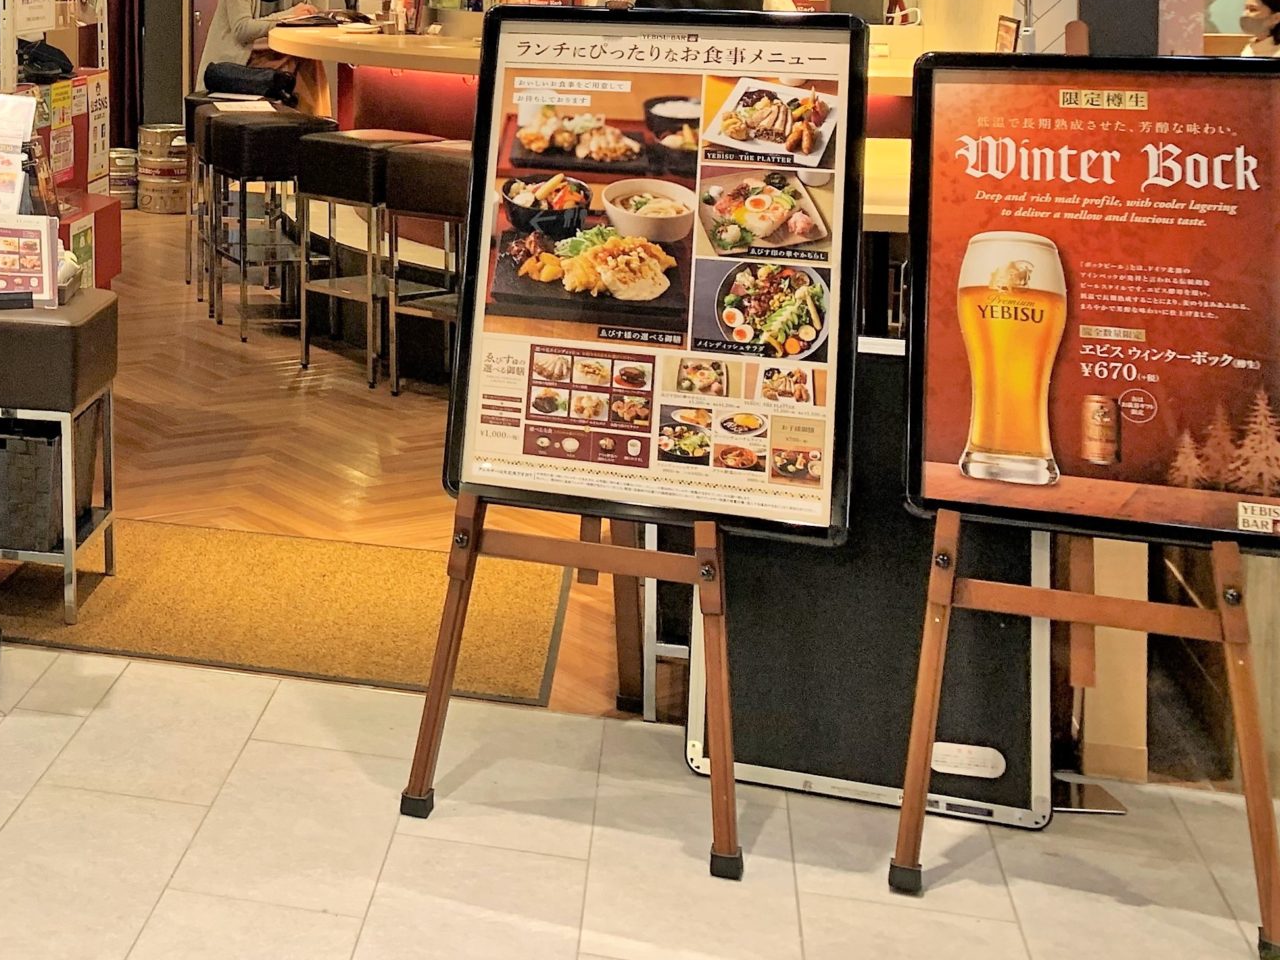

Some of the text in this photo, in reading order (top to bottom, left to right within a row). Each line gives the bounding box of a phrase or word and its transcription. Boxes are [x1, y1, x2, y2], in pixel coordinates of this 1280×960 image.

[516, 40, 828, 66] ランチにぴったりなお食事メニュー
[518, 80, 625, 90] おいしいお食事をご用意して
[1061, 91, 1147, 109] 限定樽生
[976, 115, 1238, 138] 低温で長期熟成させた、芳醇な味わい。
[706, 152, 735, 161] YEBISU
[756, 155, 792, 164] PLATTER
[954, 134, 1261, 193] Winter Bock
[975, 190, 1239, 215] Deep and rich malt profile, with cooler lagering
[1001, 208, 1012, 217] to
[1014, 207, 1052, 219] deliver
[1063, 209, 1103, 221] mellow
[1105, 211, 1128, 222] and
[1129, 213, 1175, 225] luscious
[1177, 216, 1208, 227] taste.
[987, 295, 1036, 307] Premium
[977, 305, 1044, 324] YEBISU
[1242, 518, 1270, 530] BAR
